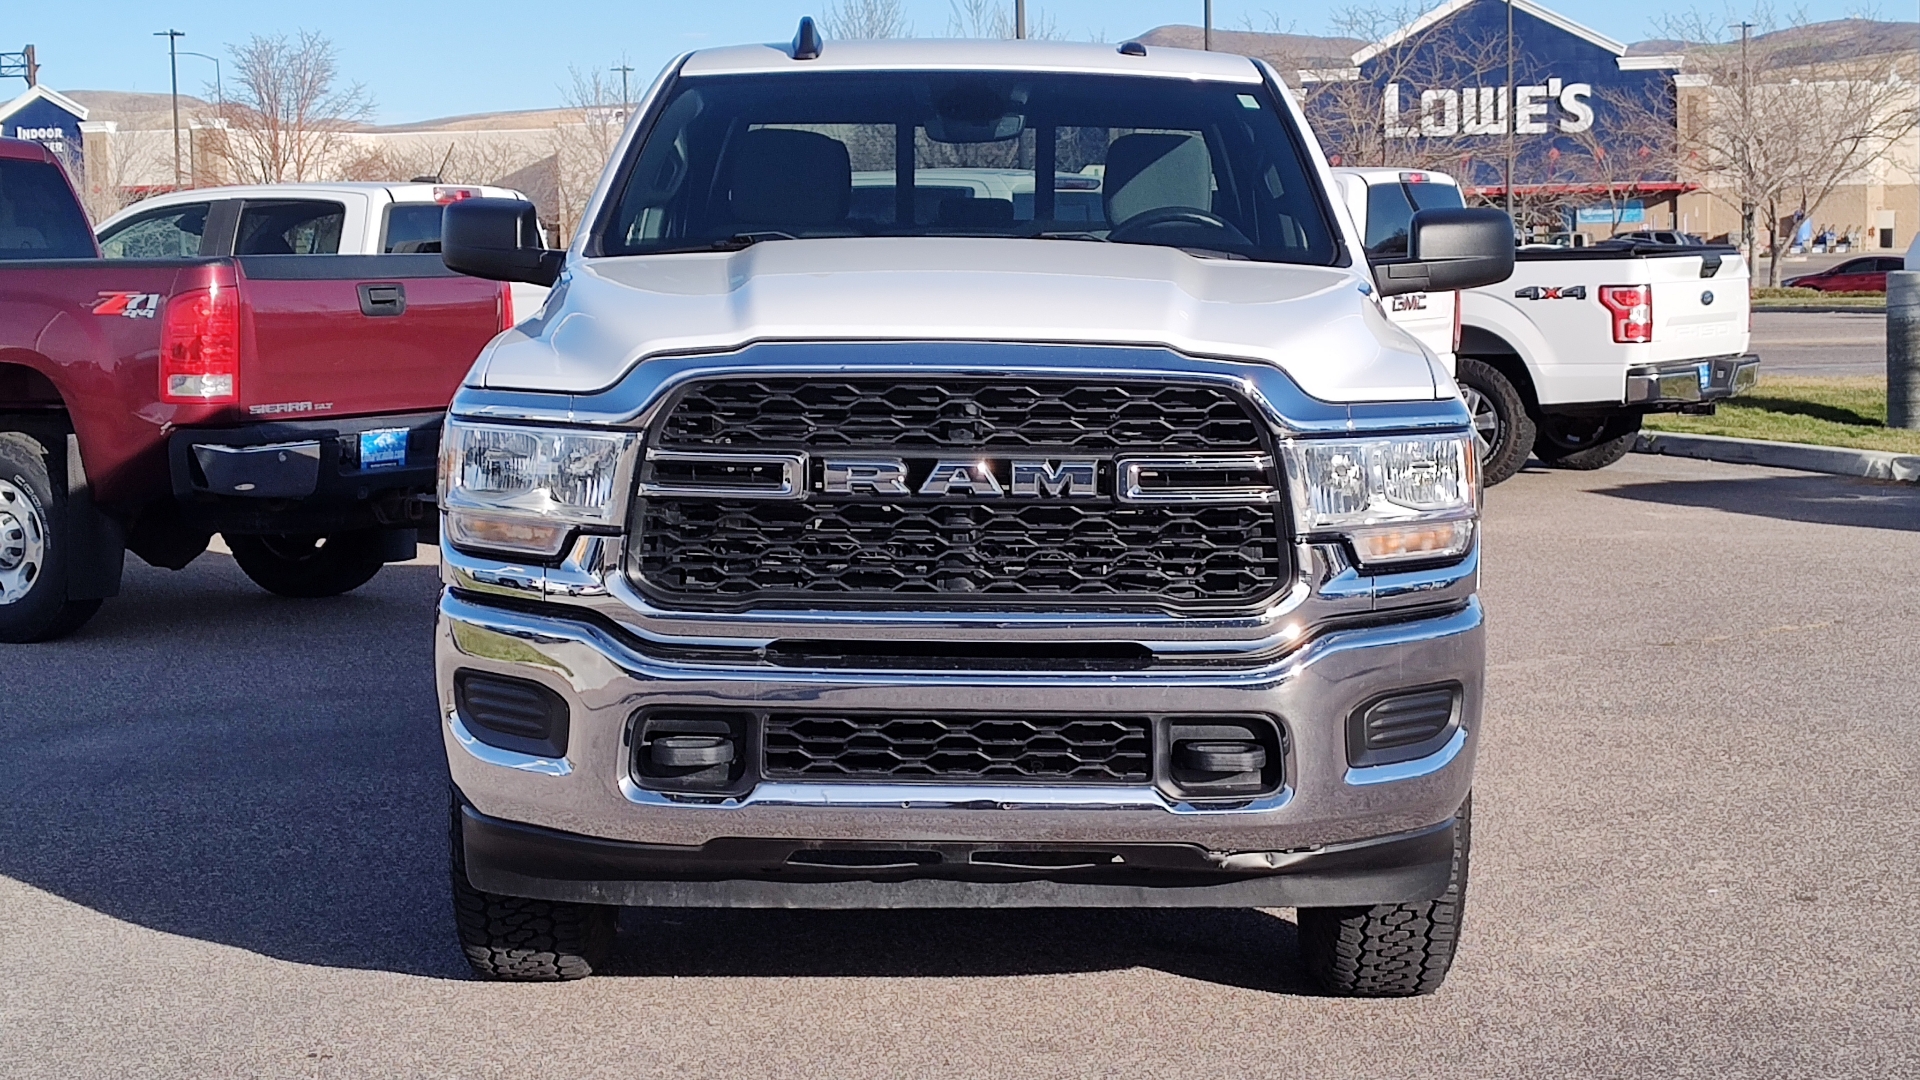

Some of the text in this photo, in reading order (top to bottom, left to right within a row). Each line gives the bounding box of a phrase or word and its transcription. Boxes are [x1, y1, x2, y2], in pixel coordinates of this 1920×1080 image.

[1384, 78, 1594, 137] LOWE'S
[16, 126, 63, 140] INDOOR
[92, 291, 159, 314] Z71
[1392, 294, 1426, 312] GMC
[249, 401, 312, 414] SIERRA
[823, 458, 1099, 495] RAM
